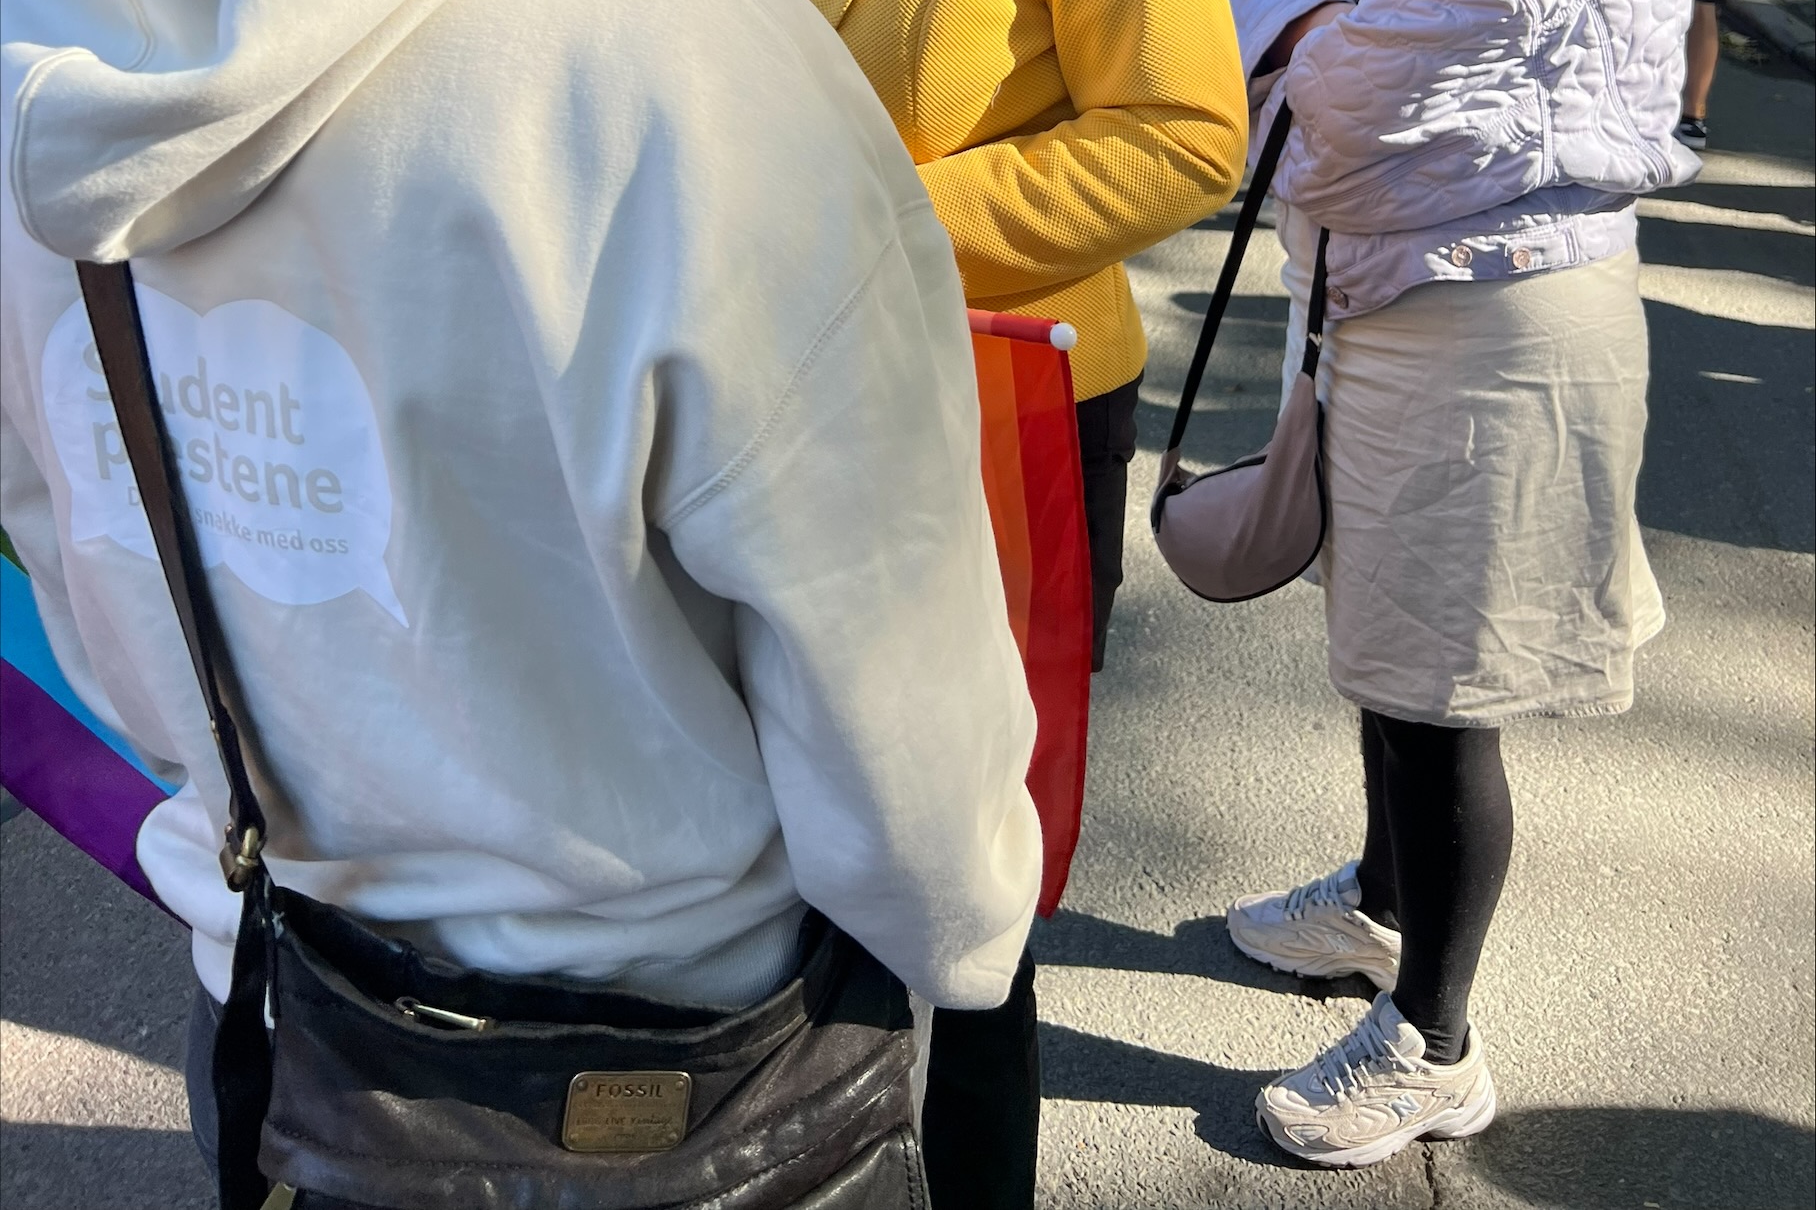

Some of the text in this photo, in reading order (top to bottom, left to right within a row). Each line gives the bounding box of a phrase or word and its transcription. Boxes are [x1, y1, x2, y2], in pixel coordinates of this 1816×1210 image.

[83, 340, 306, 445] Sdent
[92, 421, 344, 514] pstene
[193, 508, 253, 542] snakke
[256, 529, 304, 551] med
[310, 537, 350, 555] oss
[596, 1084, 663, 1098] FOSSIL
[1389, 1092, 1423, 1118] N
